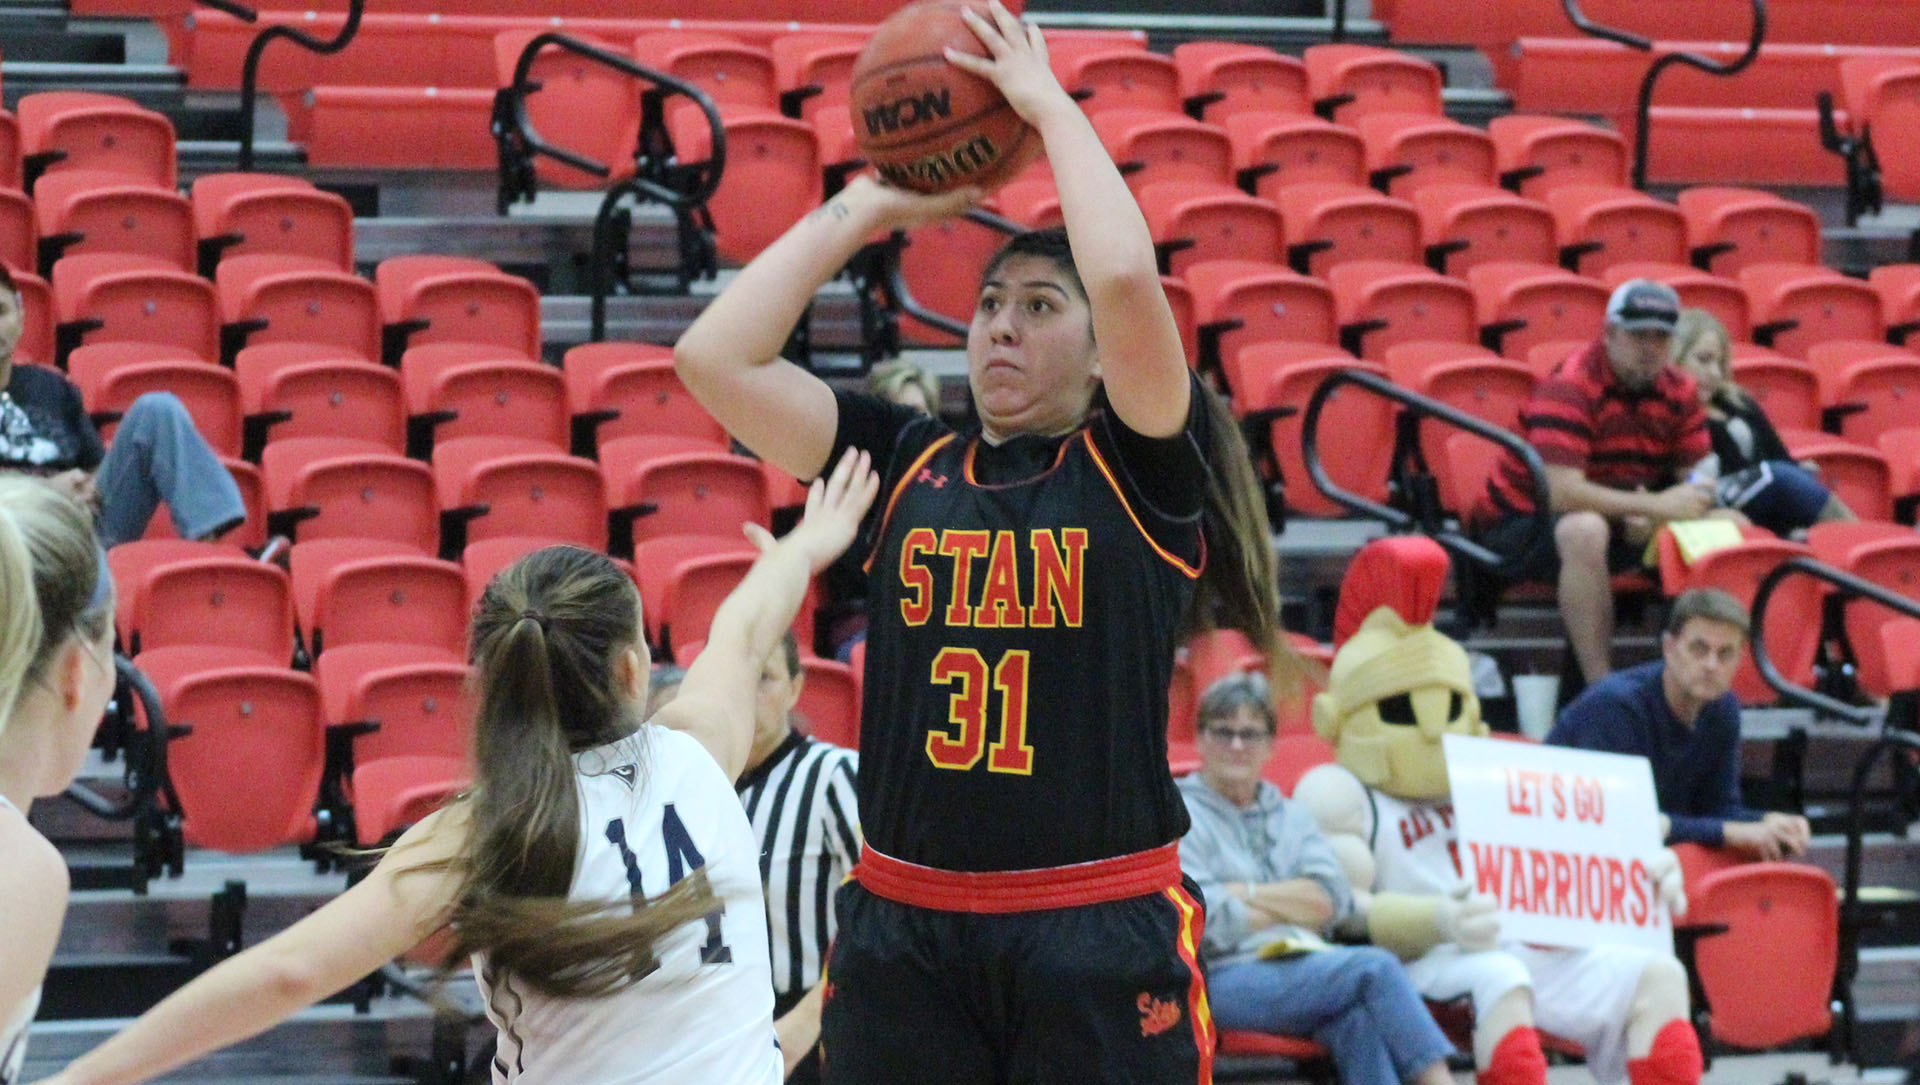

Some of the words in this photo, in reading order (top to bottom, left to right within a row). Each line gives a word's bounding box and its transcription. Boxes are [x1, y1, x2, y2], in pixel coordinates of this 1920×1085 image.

[899, 528, 1088, 627] STAN
[925, 647, 1034, 775] 31
[1505, 768, 1567, 820] LETS
[1574, 775, 1604, 824] GO
[604, 801, 734, 978] 14
[1468, 841, 1660, 928] WARRIORS!
